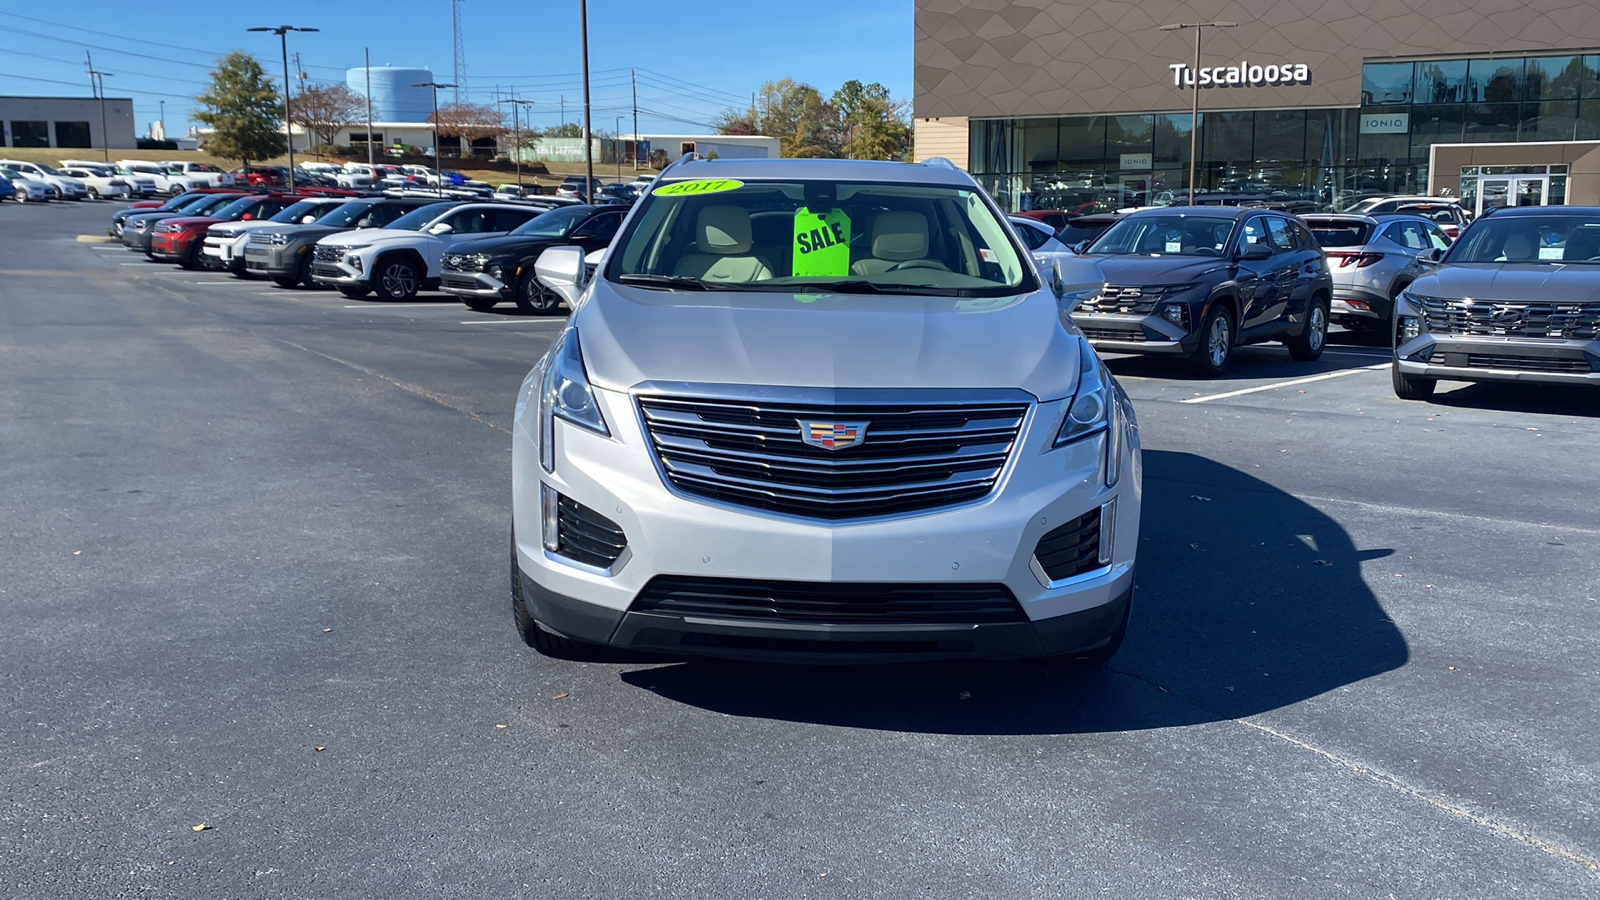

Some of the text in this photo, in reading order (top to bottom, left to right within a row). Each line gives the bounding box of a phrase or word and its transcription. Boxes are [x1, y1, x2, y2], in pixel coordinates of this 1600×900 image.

[1169, 61, 1309, 86] Tuscaloosa
[667, 181, 728, 195] 2017
[796, 222, 846, 255] SALE
